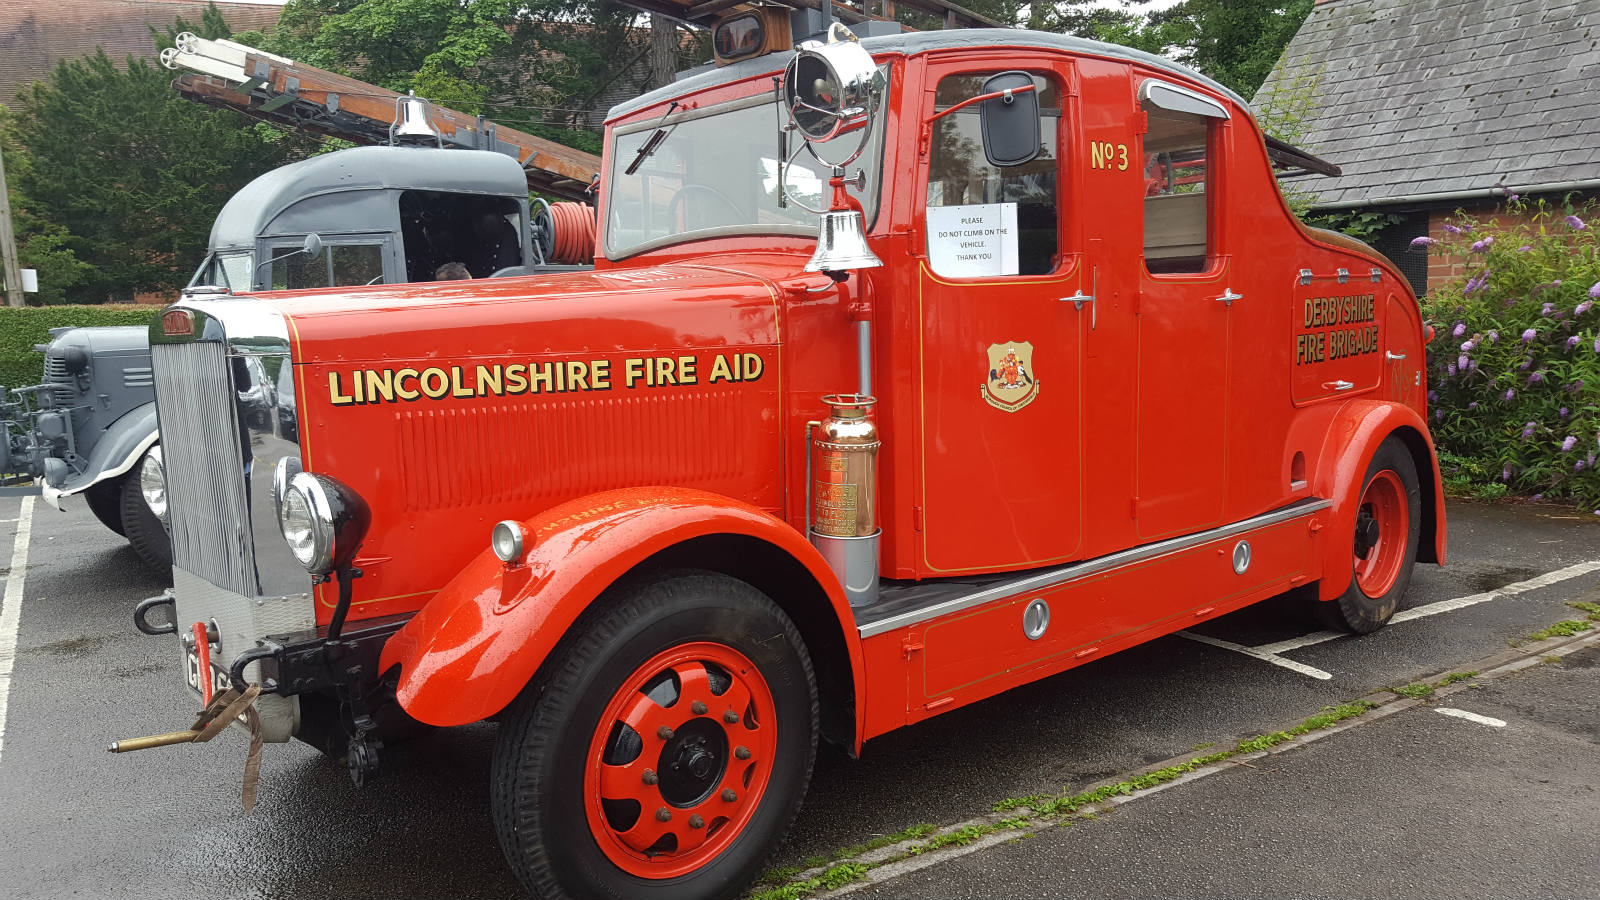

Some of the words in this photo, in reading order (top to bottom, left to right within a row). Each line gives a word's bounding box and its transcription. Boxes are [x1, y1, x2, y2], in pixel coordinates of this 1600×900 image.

[949, 230, 963, 238] NOT
[963, 229, 983, 237] CLIMB
[984, 228, 995, 236] ON
[961, 217, 984, 225] PLEASE
[1304, 294, 1375, 328] DERBYSHIRE
[1296, 332, 1325, 365] FIRE
[1329, 326, 1378, 360] BRIGADE
[329, 361, 611, 404] LINCOLNSHIRE
[626, 356, 697, 387] FIRE
[709, 353, 763, 383] AID
